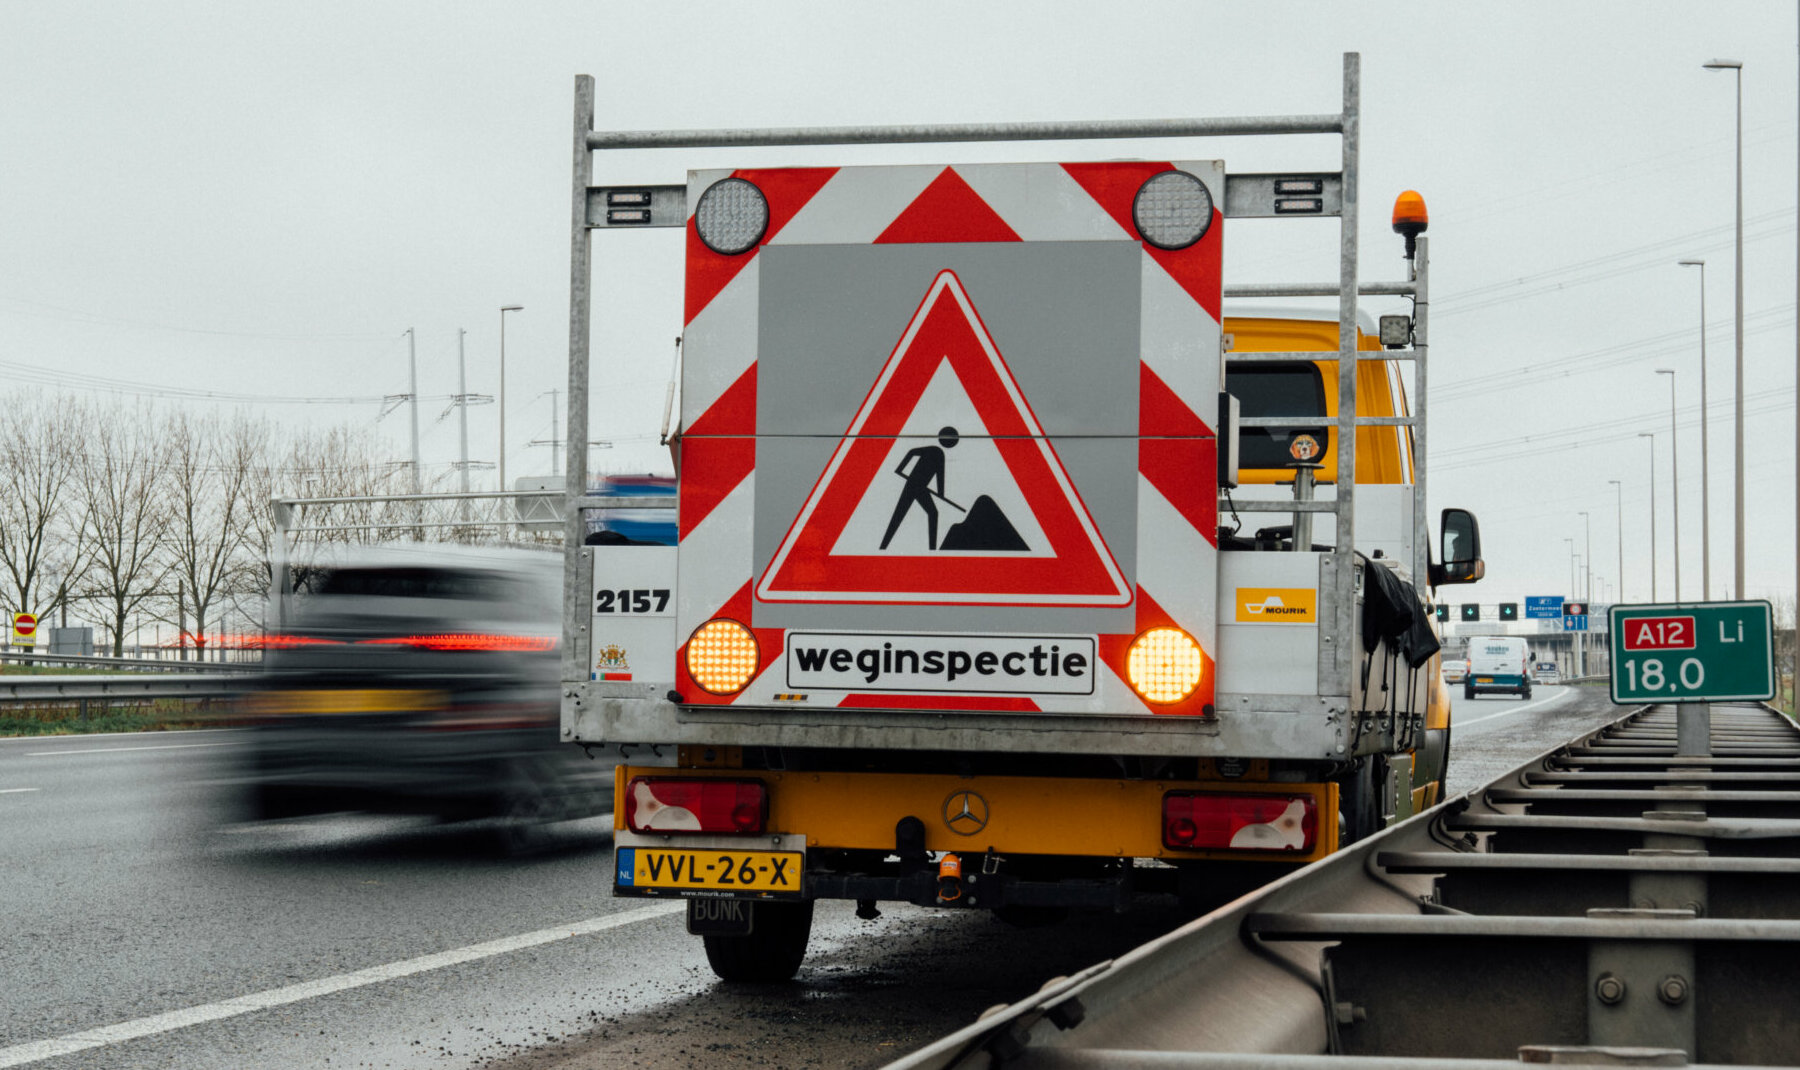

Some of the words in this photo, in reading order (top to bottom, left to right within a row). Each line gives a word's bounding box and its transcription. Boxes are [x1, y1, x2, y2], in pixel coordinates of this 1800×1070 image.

[596, 589, 671, 613] 2157
[1265, 607, 1307, 615] MOURIK
[1636, 622, 1685, 646] A12
[1719, 620, 1744, 643] Li
[795, 642, 1088, 684] weginspectie
[1624, 657, 1705, 693] 18,0
[620, 871, 633, 880] NL
[646, 853, 789, 886] VVL-26-X
[680, 890, 735, 898] www.mourik.com
[694, 899, 745, 921] BUNK
